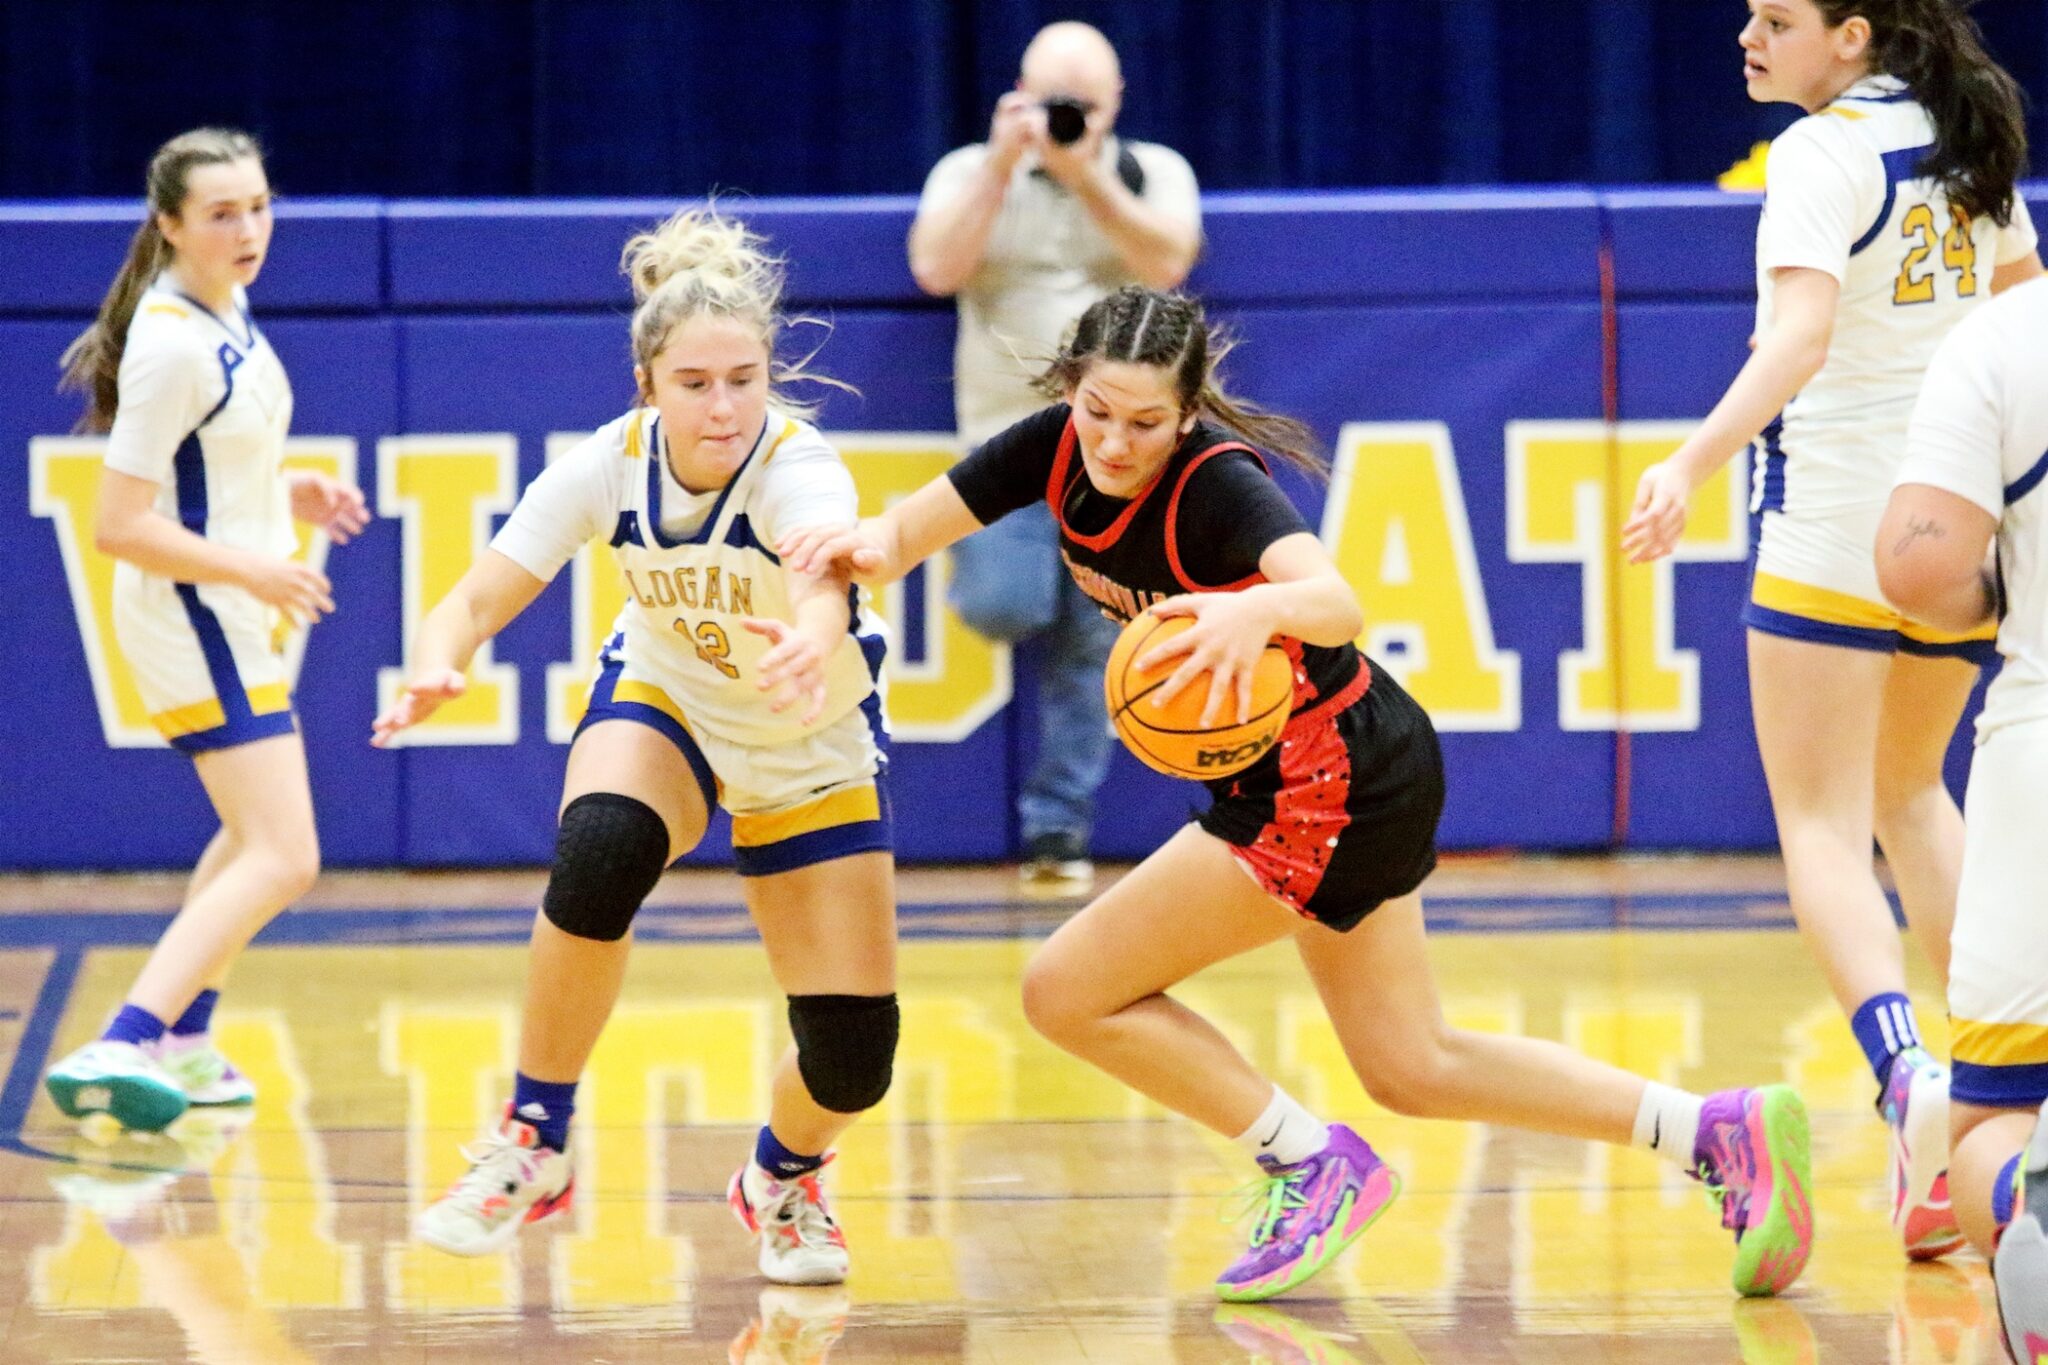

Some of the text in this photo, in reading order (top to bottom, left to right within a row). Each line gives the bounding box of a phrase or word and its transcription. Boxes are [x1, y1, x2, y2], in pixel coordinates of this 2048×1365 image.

[1892, 203, 1976, 305] 24
[625, 566, 753, 616] LOGAN
[673, 617, 740, 679] 12
